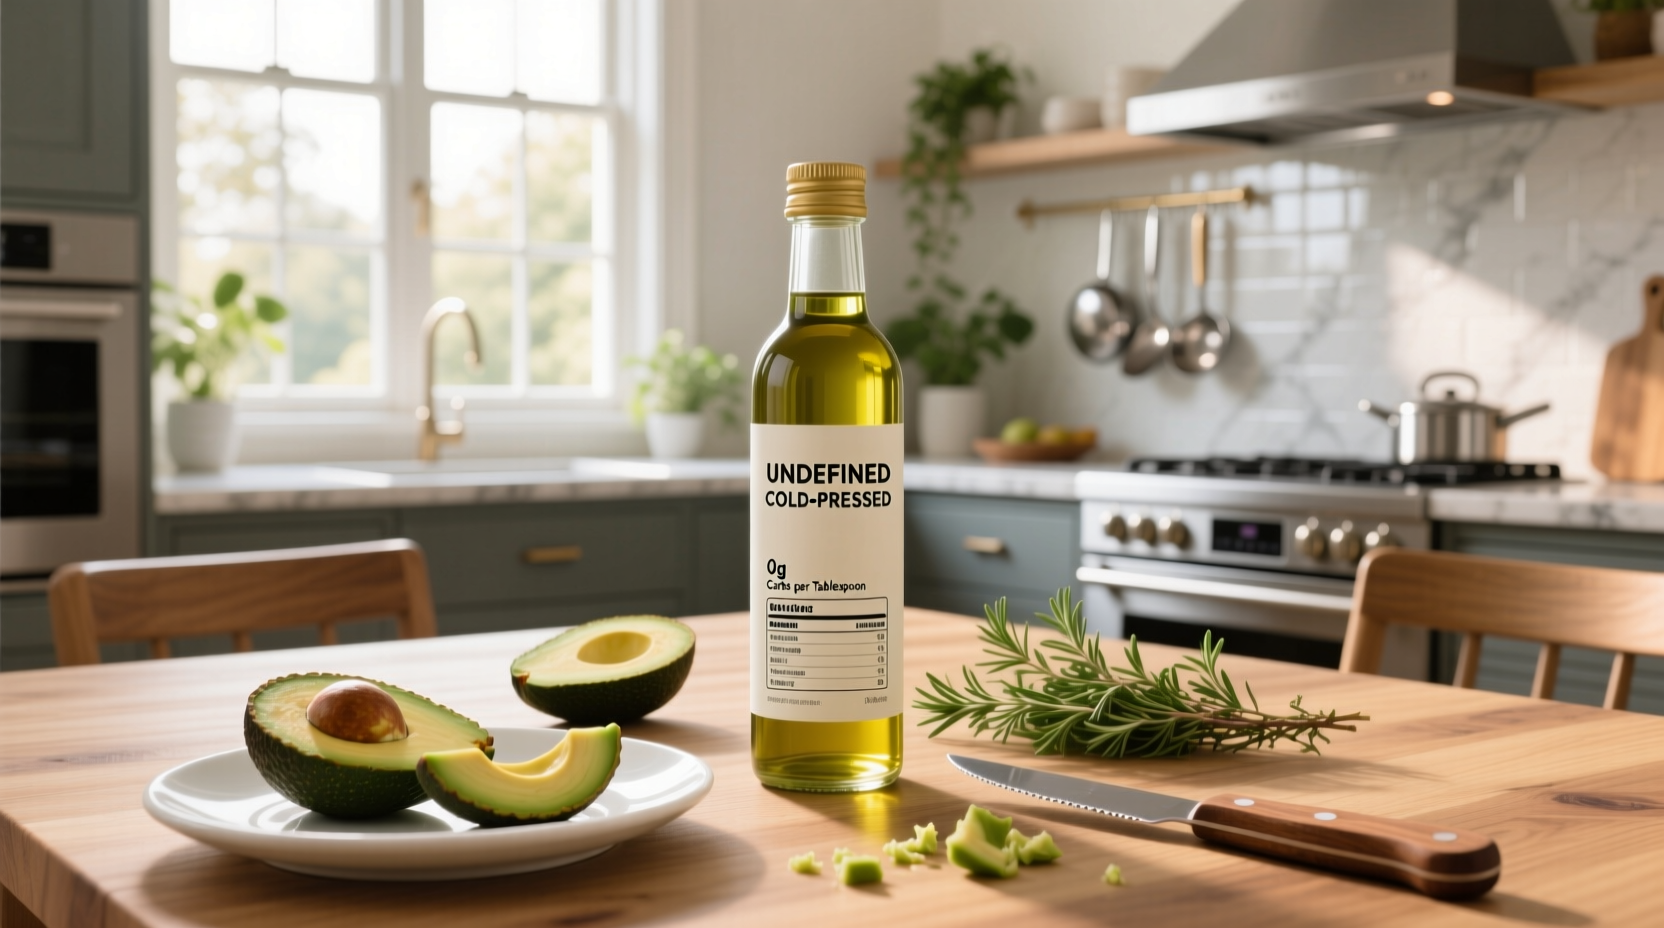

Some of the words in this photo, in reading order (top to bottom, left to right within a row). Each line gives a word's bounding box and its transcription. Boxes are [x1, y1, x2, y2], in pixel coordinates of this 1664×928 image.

[767, 463, 890, 484] UNDEFINED
[766, 491, 891, 508] COLD-PRESSED
[794, 583, 810, 594] per
